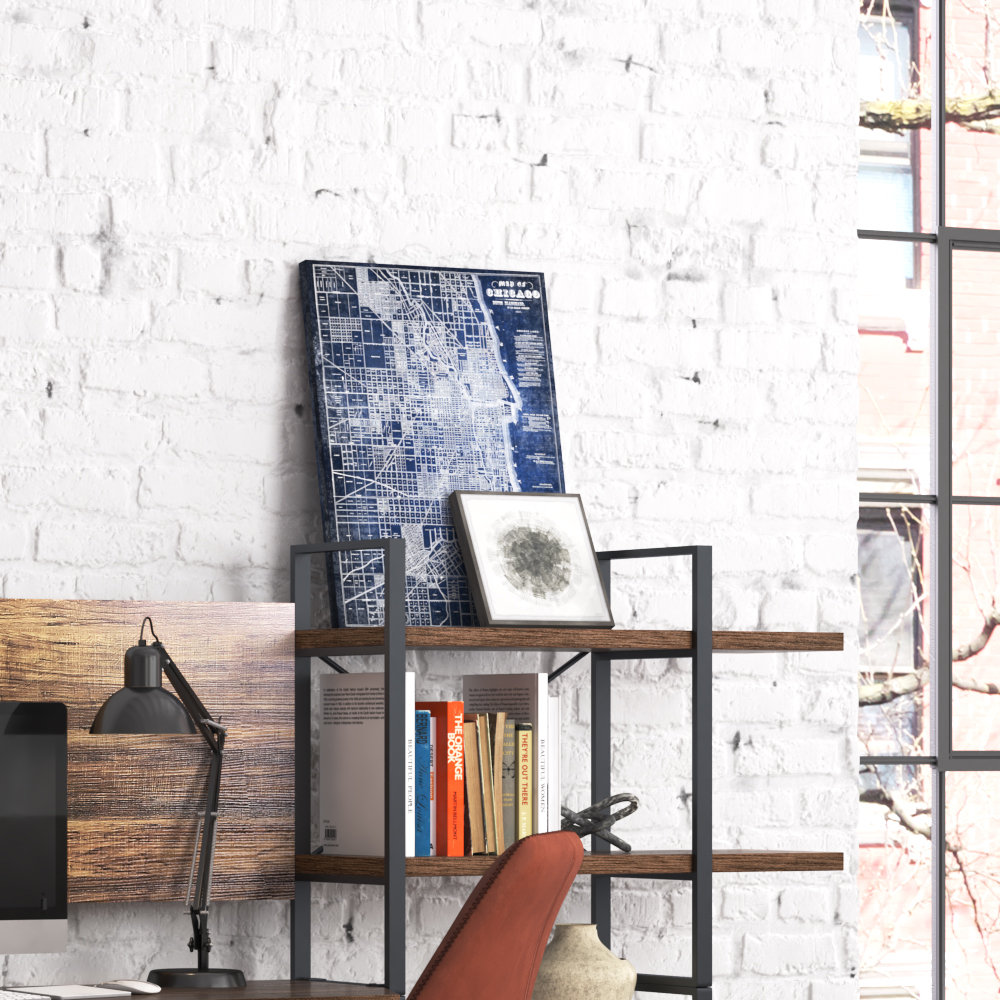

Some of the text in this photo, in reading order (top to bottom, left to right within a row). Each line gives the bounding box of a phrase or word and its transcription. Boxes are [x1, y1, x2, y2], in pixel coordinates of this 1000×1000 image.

[486, 288, 540, 298] CHICAGO
[447, 732, 455, 764] BOOK
[454, 713, 463, 781] THE ORANGE
